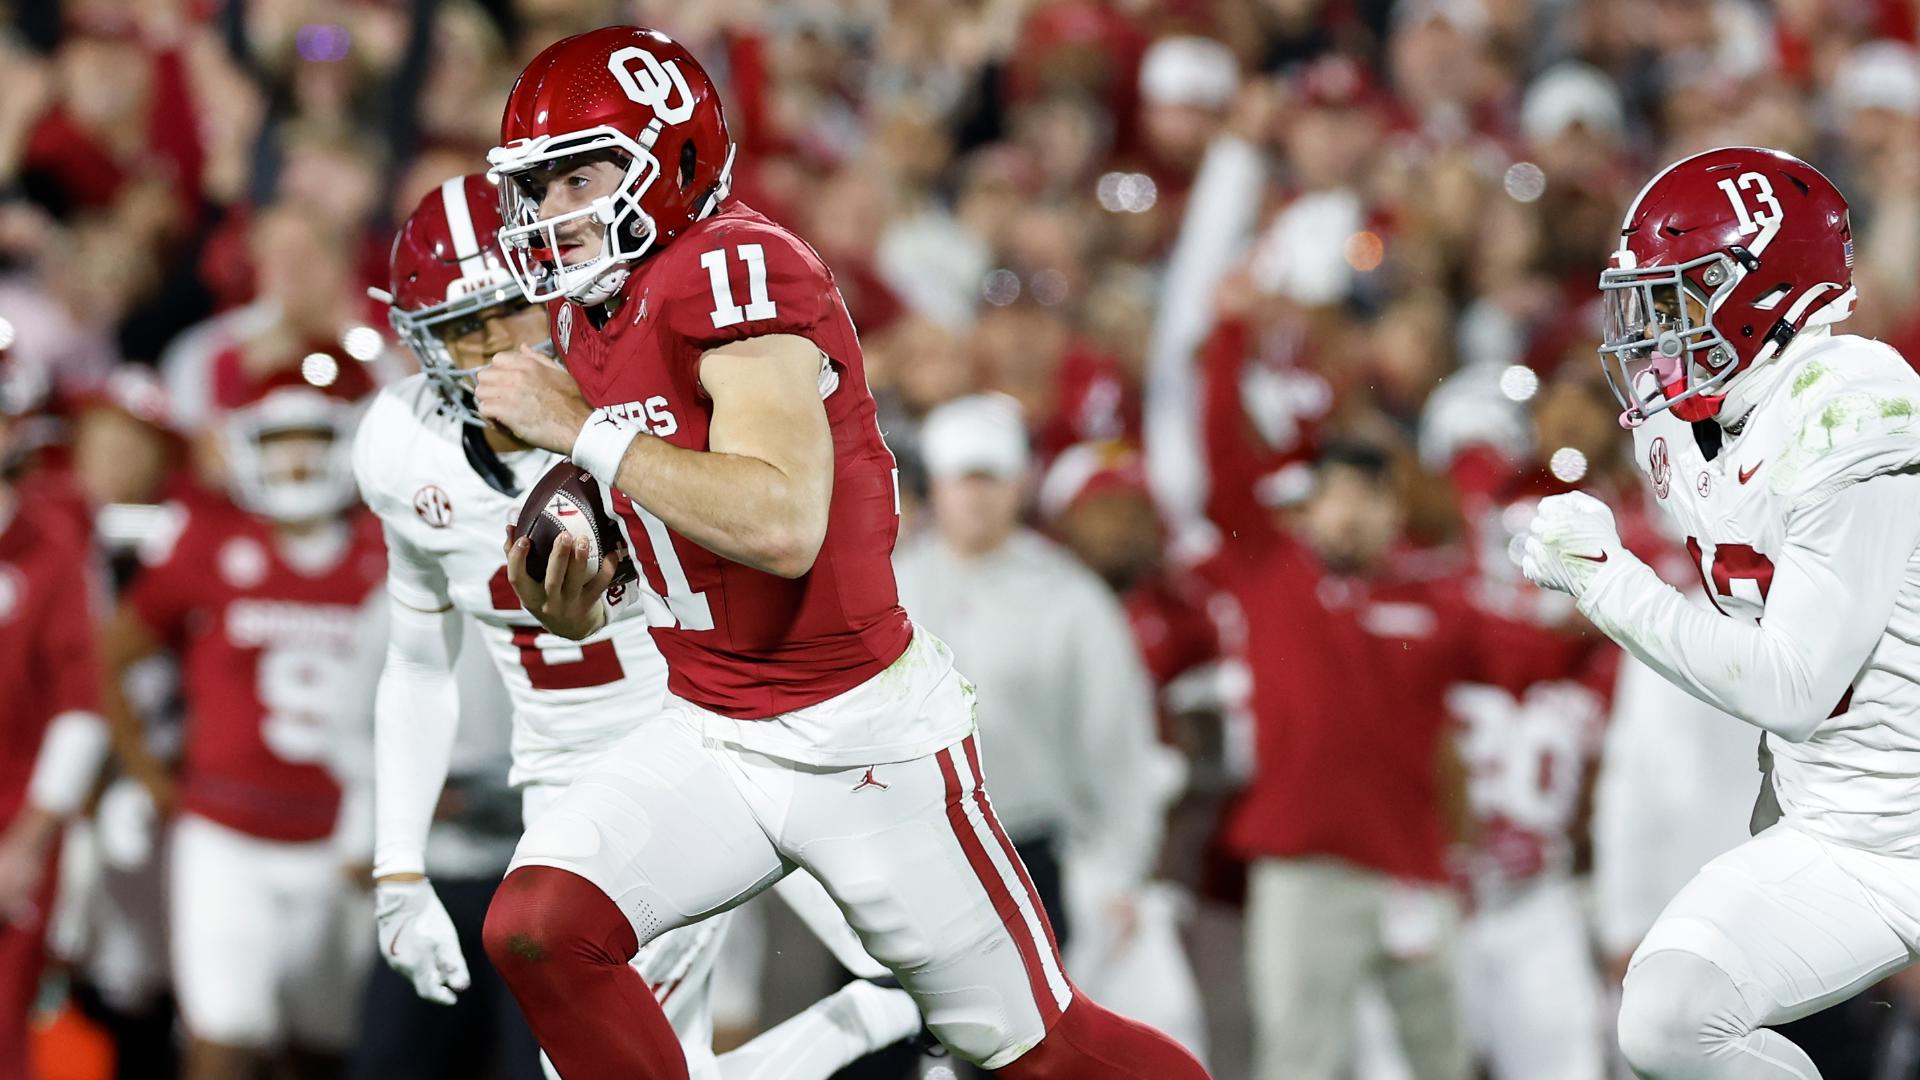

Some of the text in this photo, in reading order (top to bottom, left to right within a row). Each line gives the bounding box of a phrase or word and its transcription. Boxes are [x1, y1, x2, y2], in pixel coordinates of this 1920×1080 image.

[607, 46, 696, 126] OU
[1716, 171, 1784, 236] 13
[700, 243, 778, 329] 11
